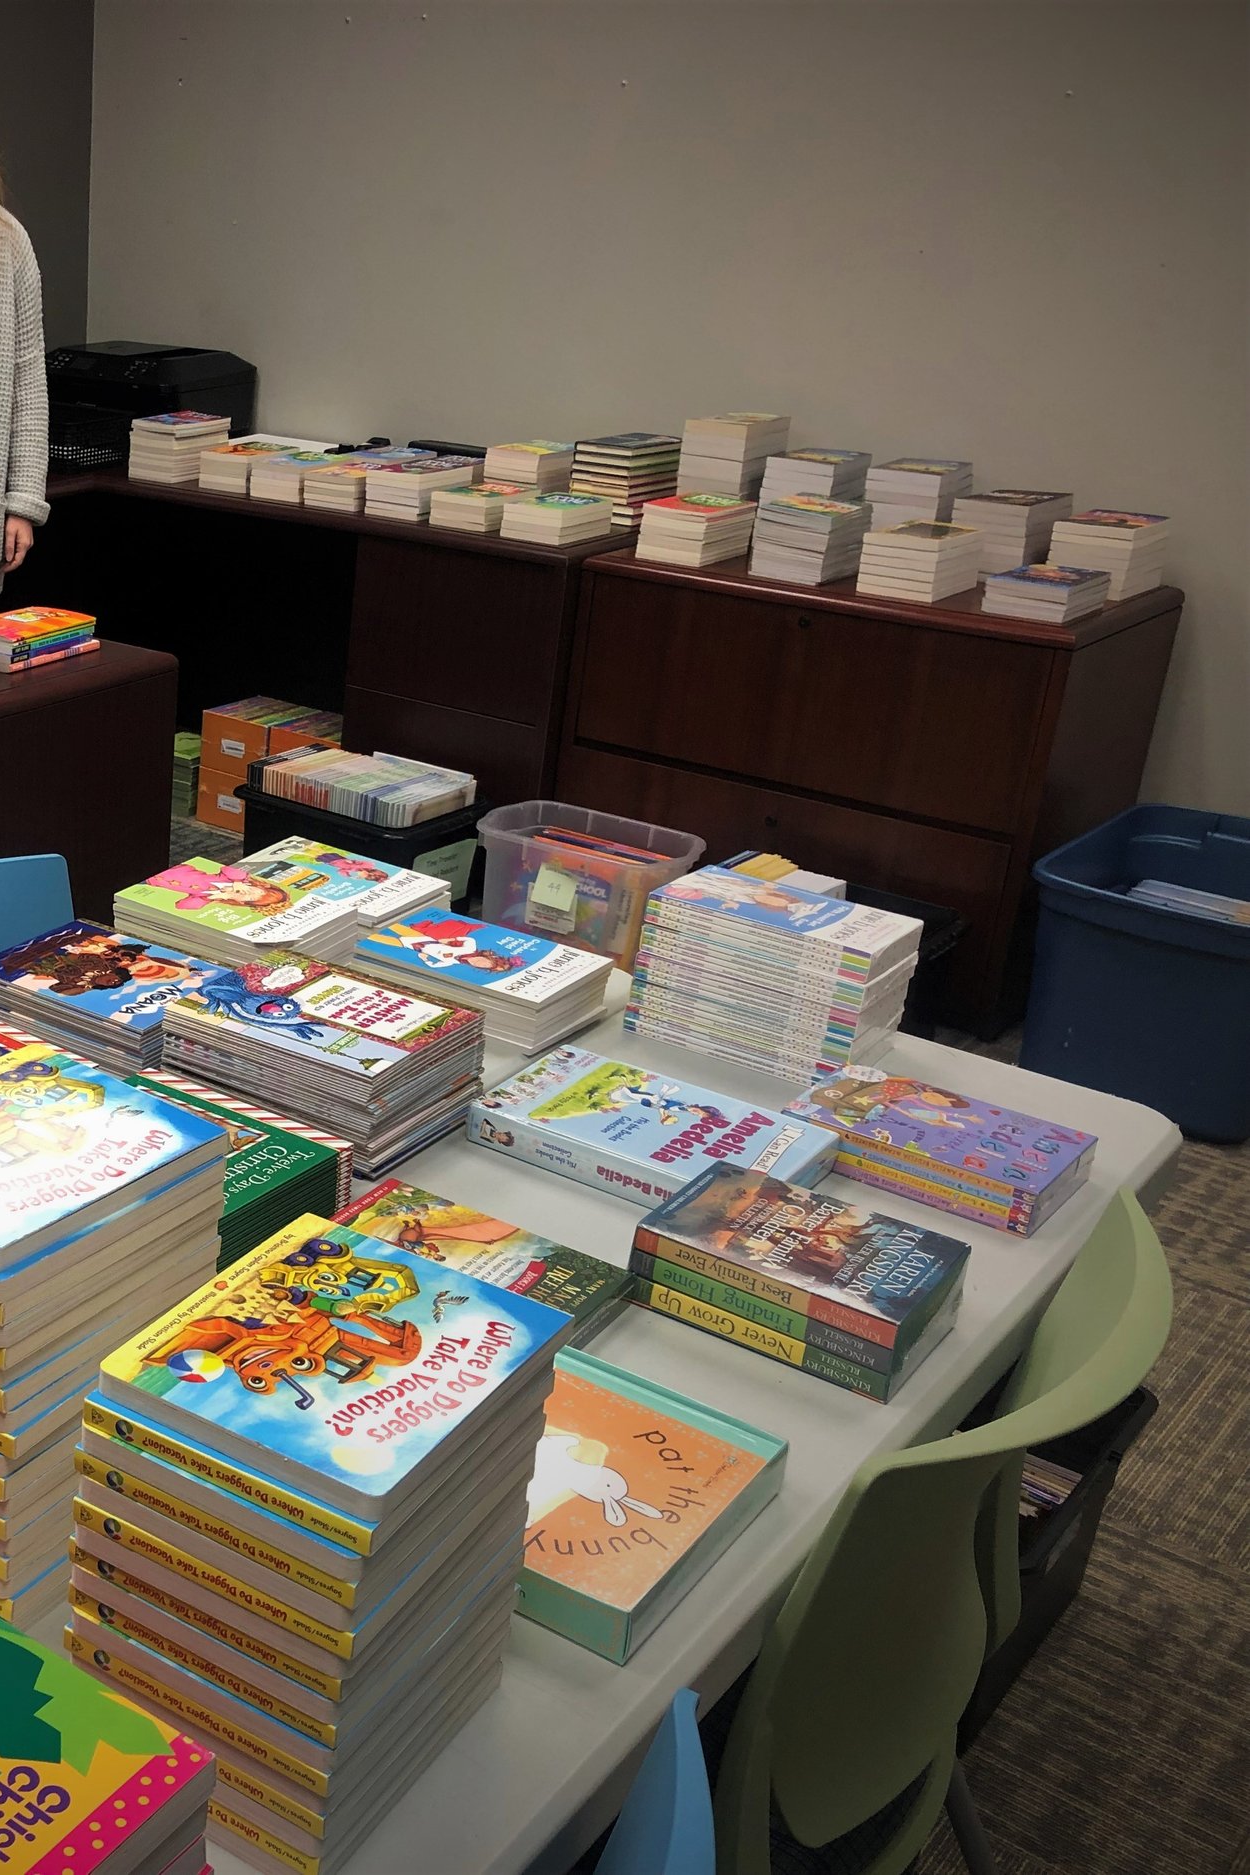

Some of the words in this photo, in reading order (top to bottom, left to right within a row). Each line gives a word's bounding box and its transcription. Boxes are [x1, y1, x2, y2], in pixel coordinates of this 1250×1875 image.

[118, 984, 183, 1014] MOANA
[354, 998, 414, 1028] MONSTER
[118, 1129, 173, 1167] Where
[649, 1115, 731, 1166] Bedelia
[702, 1111, 775, 1162] Amelia
[770, 1137, 790, 1150] Can
[91, 1165, 126, 1182] Do
[223, 1144, 288, 1182] Christm
[262, 1150, 316, 1176] Twelve
[754, 1150, 780, 1170] Read!
[227, 1173, 271, 1195] Days
[597, 1165, 652, 1195] Bedelia
[5, 1180, 97, 1213] Diggers
[750, 1203, 806, 1242] Children
[804, 1201, 845, 1234] Baxter
[675, 1249, 706, 1269] Ever
[759, 1229, 810, 1270] Family
[844, 1229, 924, 1300] KINGSBURY
[541, 1265, 576, 1290] TREE
[663, 1268, 716, 1305] Home
[708, 1259, 759, 1290] Family
[879, 1249, 935, 1294] KAREN
[657, 1288, 683, 1314] Up
[761, 1279, 792, 1305] Best
[689, 1305, 735, 1334] Grow
[724, 1288, 794, 1333] Finding
[813, 1310, 881, 1342] KINGSBURY
[421, 1335, 471, 1372] Take
[467, 1321, 516, 1371] Where
[741, 1326, 794, 1359] Never
[806, 1333, 875, 1366] KINGSBURY
[446, 1368, 487, 1394] Do
[803, 1359, 871, 1393] KINGSBURY
[324, 1372, 438, 1437] Vacation?
[366, 1391, 462, 1444] Diggers
[142, 1436, 188, 1466] Vacation?
[633, 1430, 694, 1473] pat
[190, 1458, 214, 1480] Take
[215, 1469, 253, 1496] Diggers
[132, 1488, 177, 1518] Vacation?
[255, 1488, 269, 1504] Do
[270, 1496, 304, 1520] Where
[660, 1485, 705, 1525] the
[179, 1510, 203, 1531] Take
[204, 1521, 241, 1549] Diggers
[310, 1516, 358, 1544] Sayres/Slade
[242, 1542, 257, 1557] Do
[525, 1528, 668, 1556] bunny
[257, 1549, 291, 1573] Where
[295, 1570, 343, 1599] Sayres/Slade
